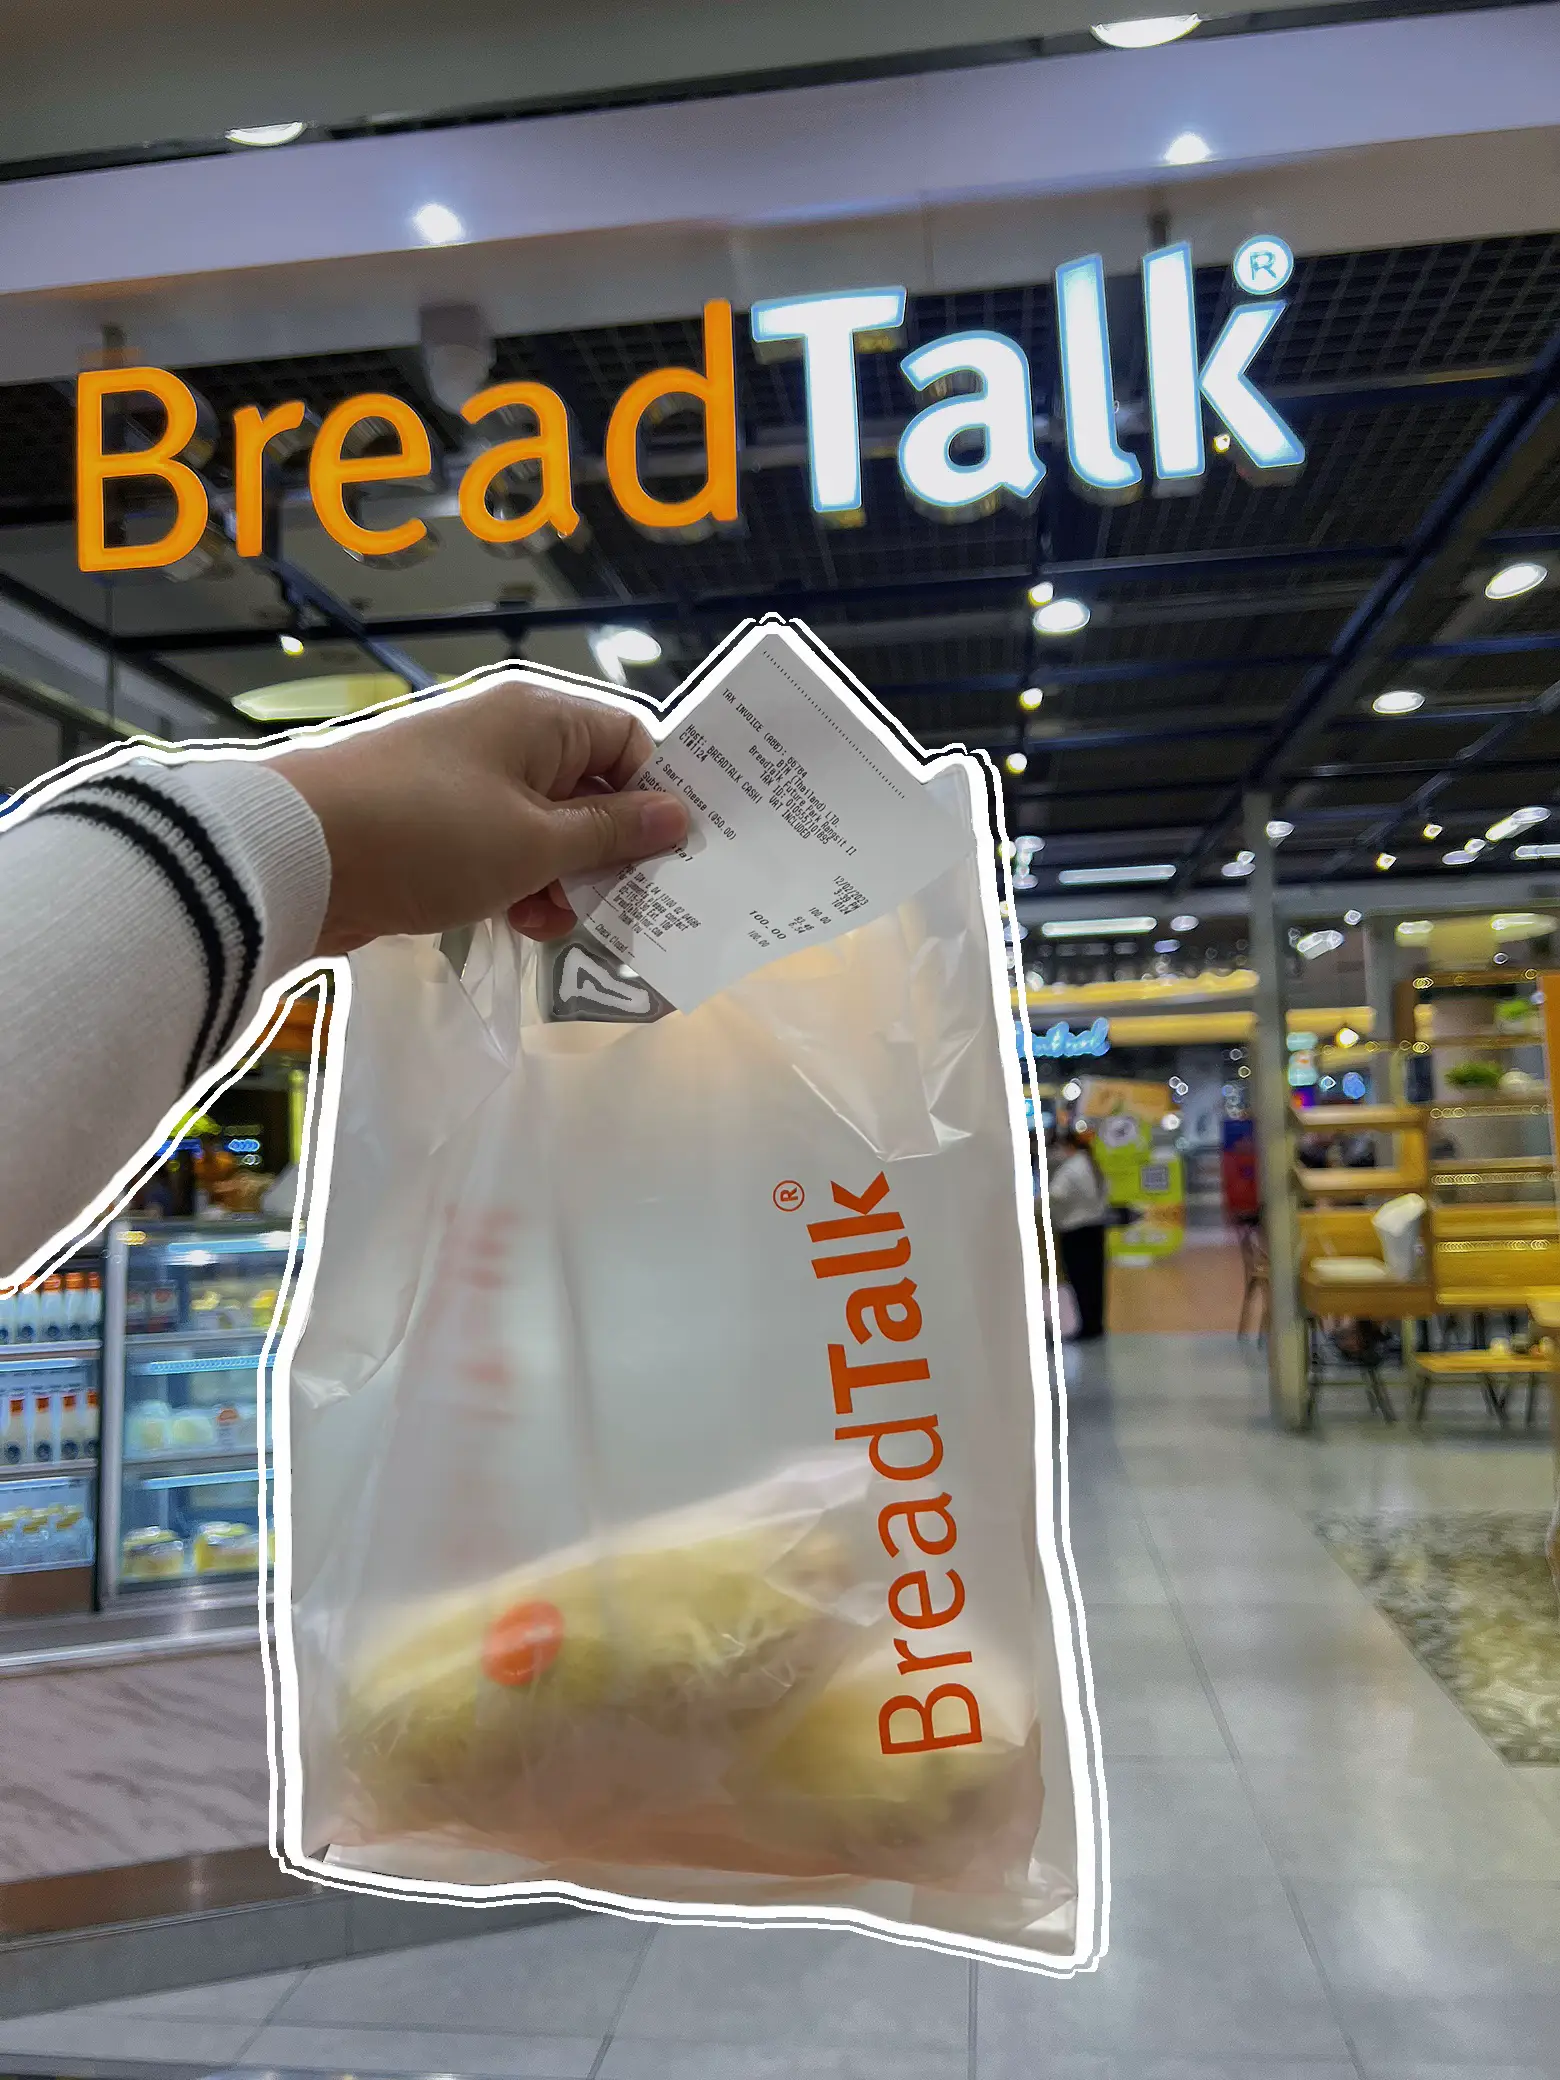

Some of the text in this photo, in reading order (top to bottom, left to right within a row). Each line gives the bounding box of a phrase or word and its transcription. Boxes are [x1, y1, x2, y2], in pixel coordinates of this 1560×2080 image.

[722, 687, 736, 704] TAX
[735, 702, 764, 732] INVOICE
[763, 732, 786, 756] (ABB):
[685, 723, 707, 747] Host:
[705, 744, 743, 783] BREADTALK
[655, 756, 663, 765] 2
[662, 763, 684, 786] Smart
[682, 784, 707, 811] Cheese
[748, 744, 786, 783] BreadTalk
[781, 779, 808, 806] Future
[804, 803, 824, 823] Park
[820, 819, 847, 847] Rangsit
[759, 769, 775, 786] TAX
[772, 784, 788, 799] ID:
[775, 758, 839, 828] BTM (Thailand) LTD.
[768, 794, 812, 839] VAT INCLUDED
[808, 906, 831, 924] 100.00
[832, 875, 868, 906] 12/02/2023
[748, 910, 786, 939] 100.00
